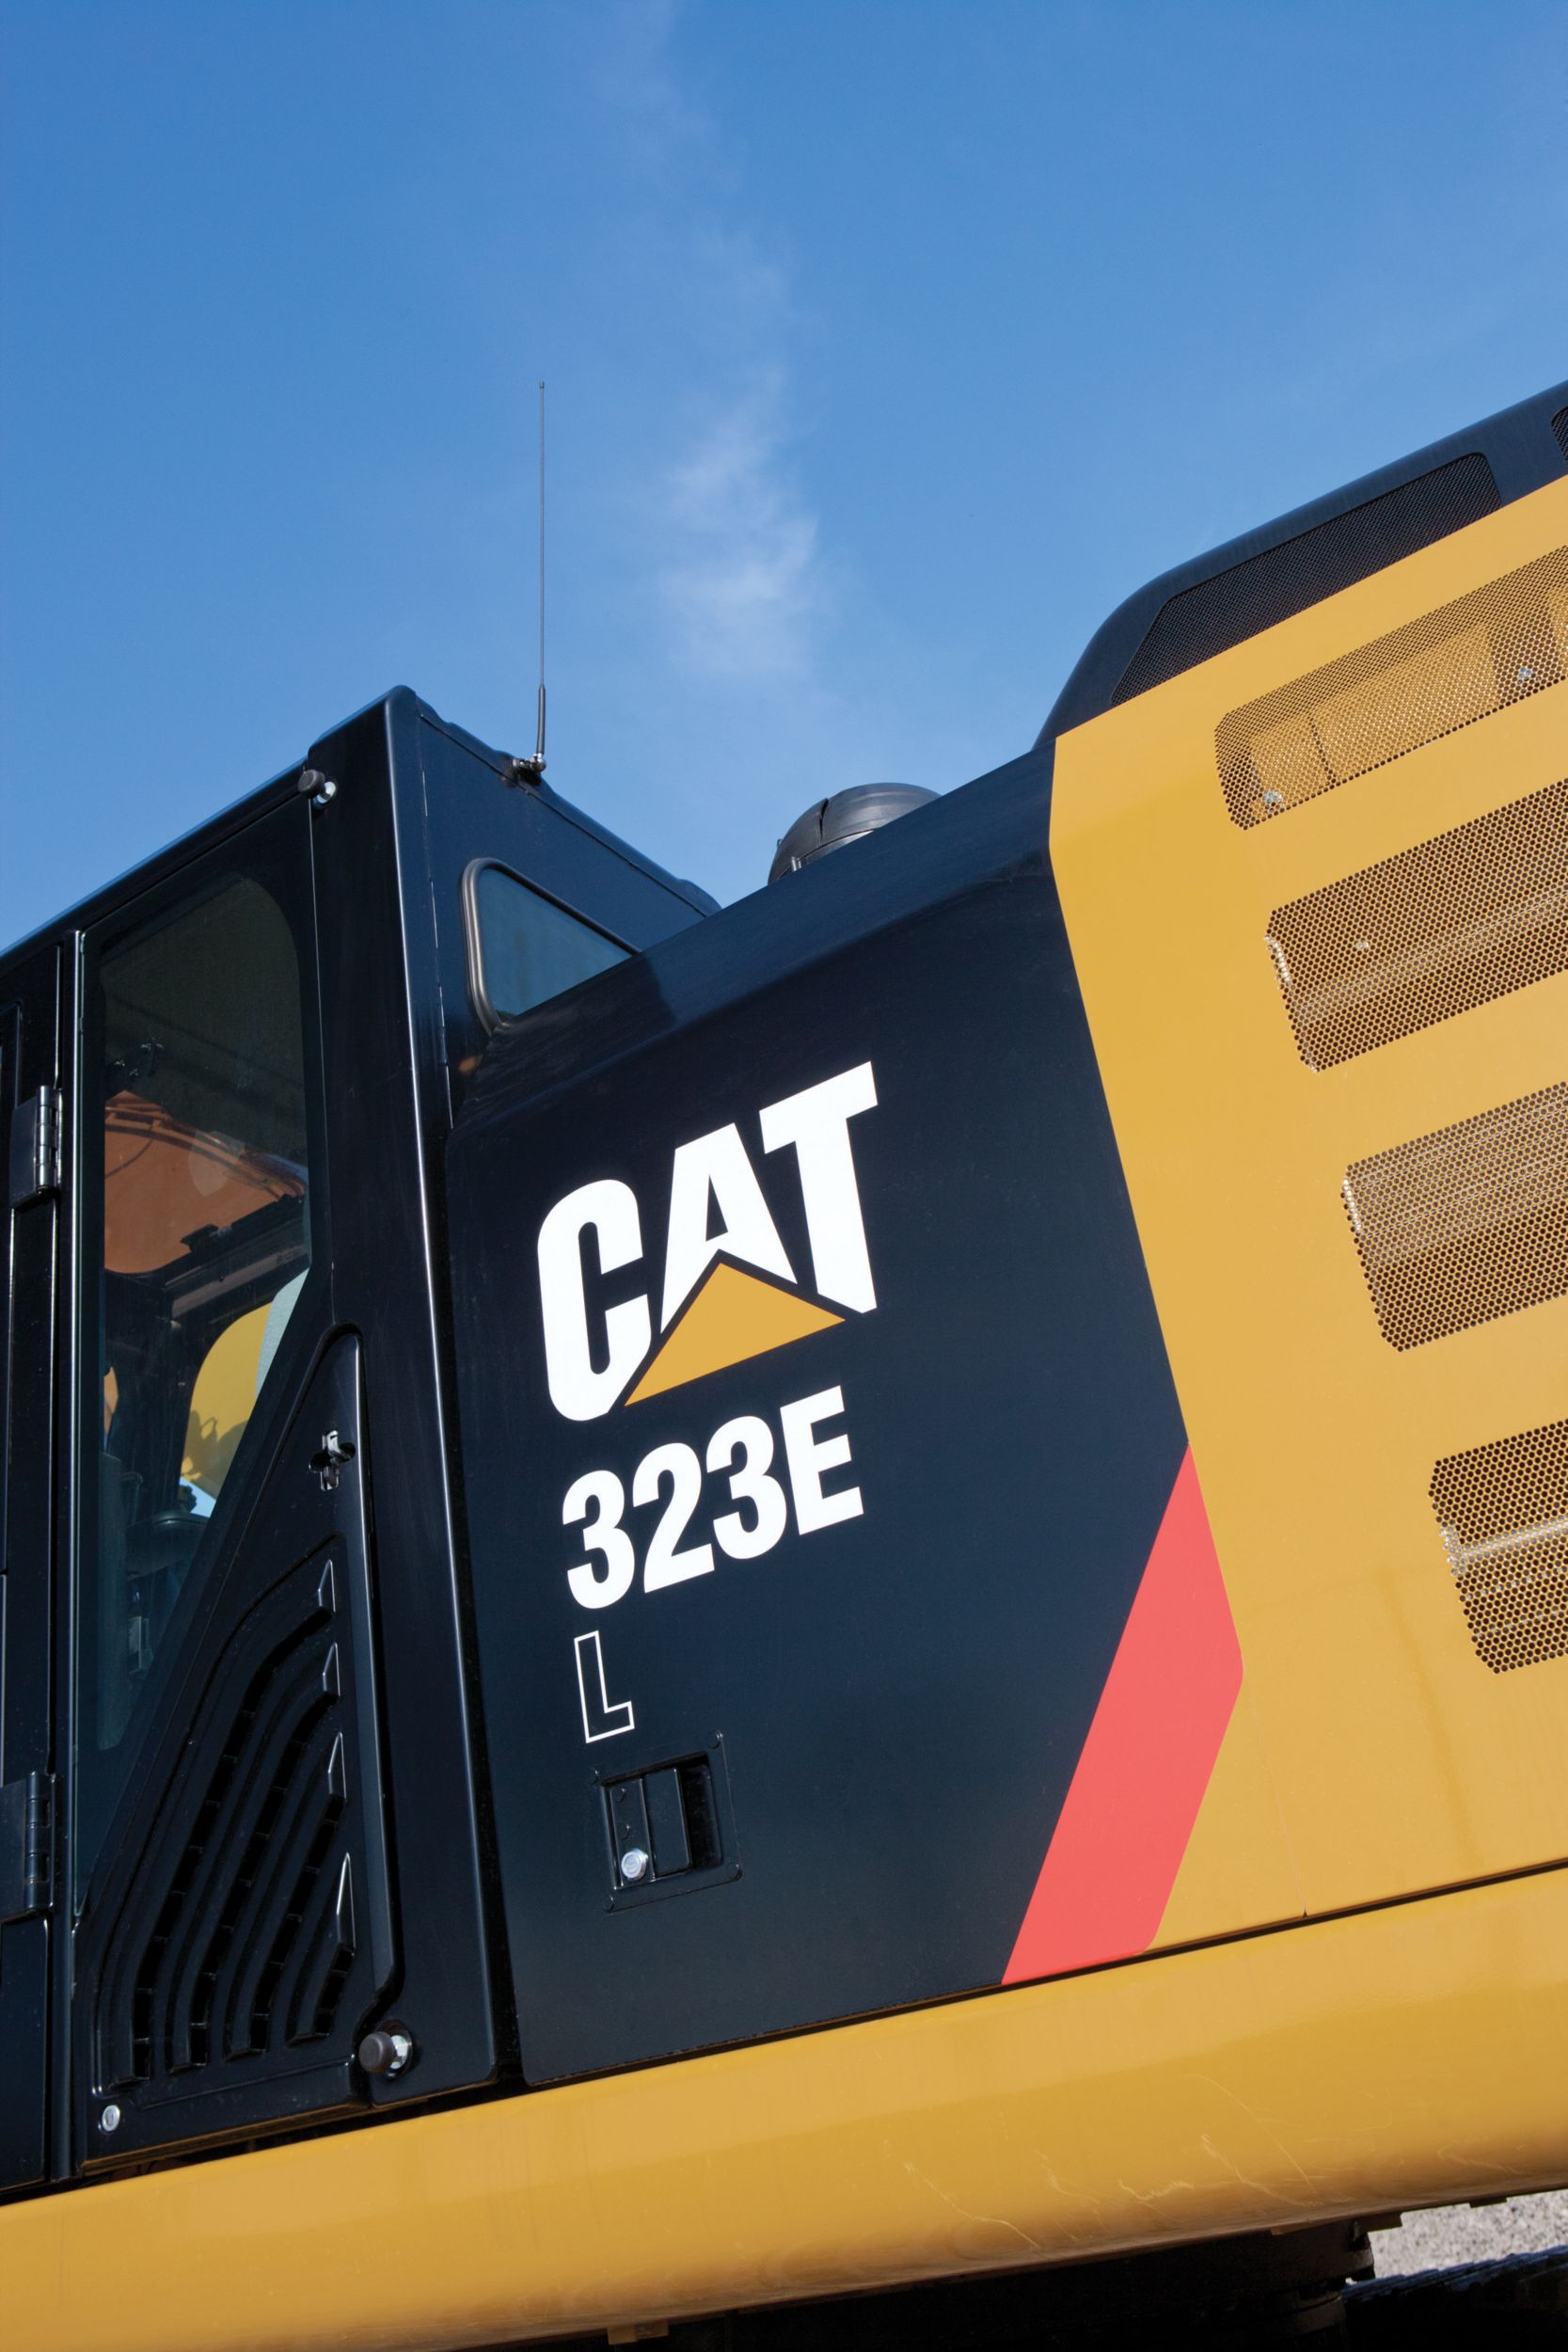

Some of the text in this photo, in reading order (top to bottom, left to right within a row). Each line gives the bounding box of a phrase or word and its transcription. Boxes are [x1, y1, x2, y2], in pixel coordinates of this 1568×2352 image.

[537, 1060, 879, 1422] CAT
[562, 1385, 864, 1610] 323E
[574, 1629, 635, 1744] L
